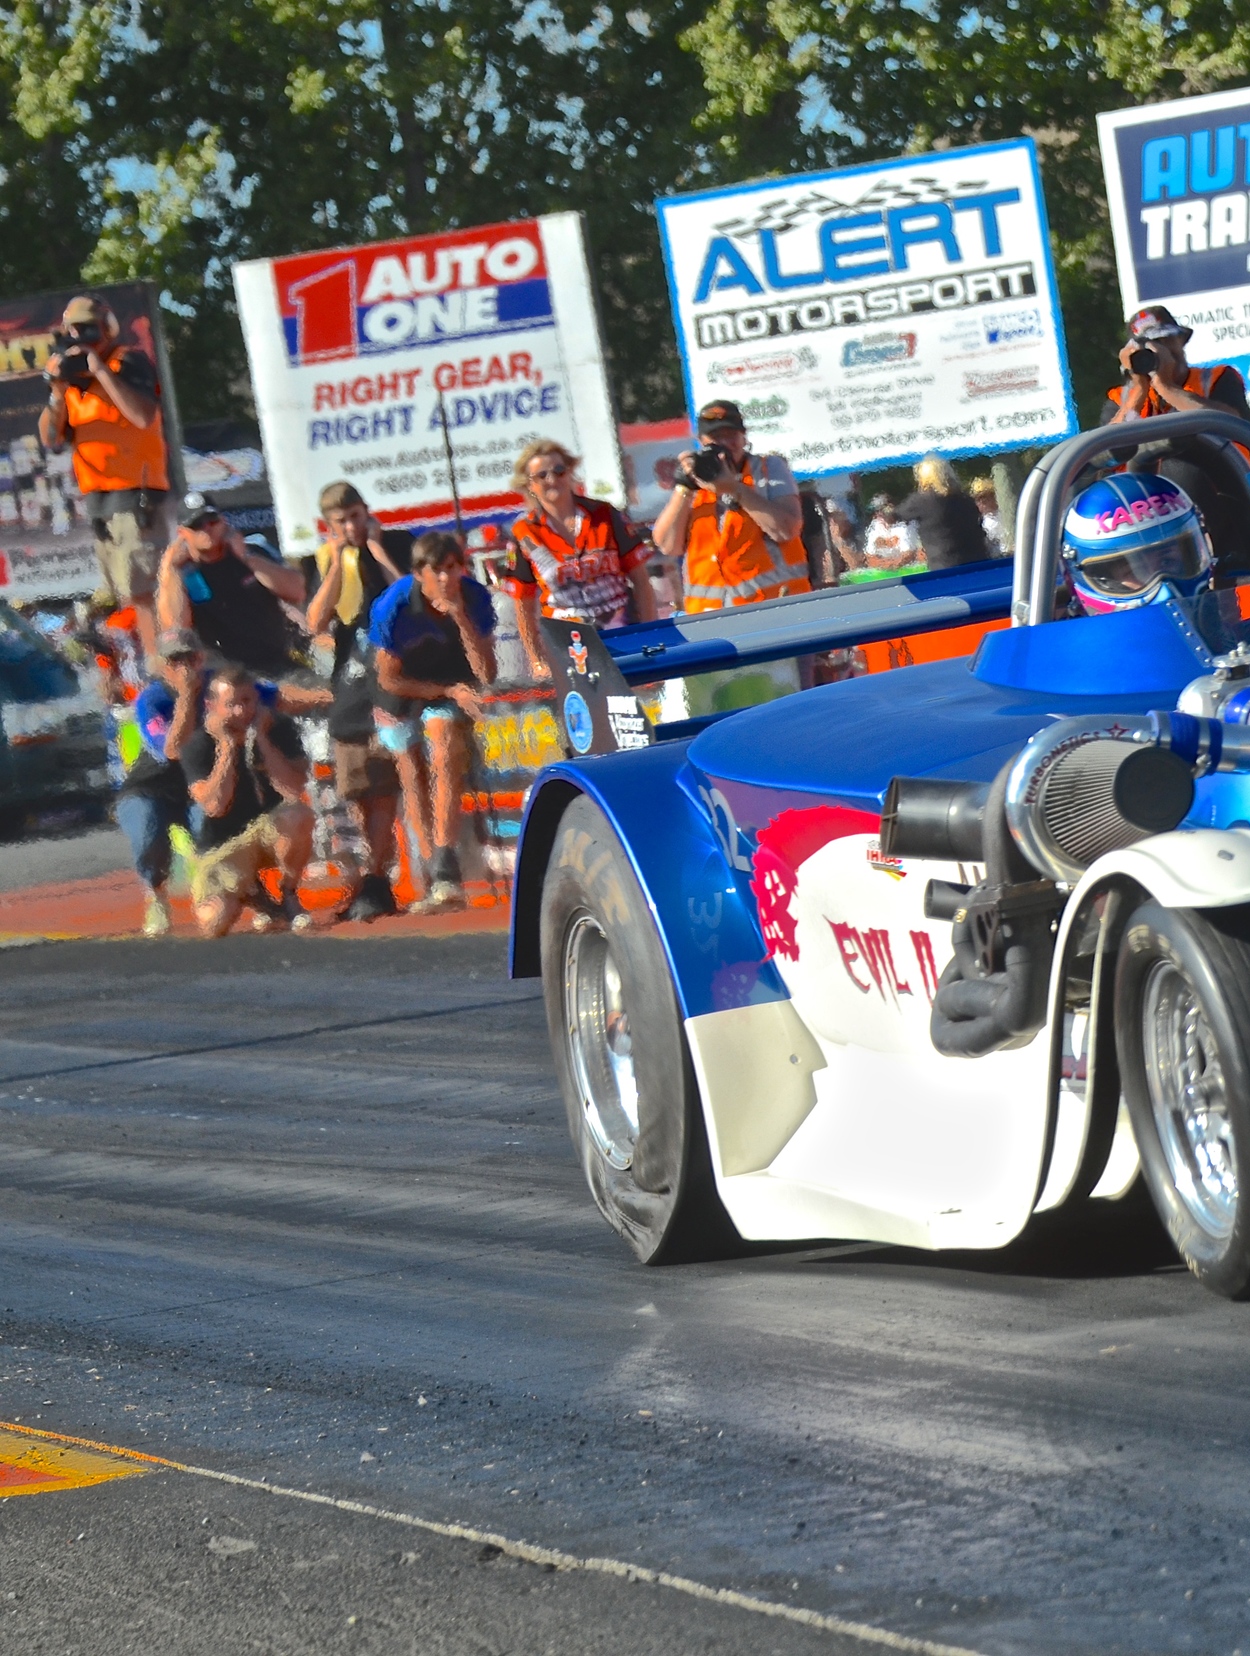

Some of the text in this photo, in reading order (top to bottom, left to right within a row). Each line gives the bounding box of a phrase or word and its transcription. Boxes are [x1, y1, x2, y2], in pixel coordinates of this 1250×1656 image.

[361, 237, 538, 301] AUTO
[692, 186, 1021, 304] ALERT
[361, 288, 499, 344] ONE
[699, 267, 1035, 346] MOTORSPORT
[312, 350, 544, 413] RIGHT GEAR,
[308, 382, 561, 450] RIGHT ADVICE
[1093, 489, 1190, 535] KAREN
